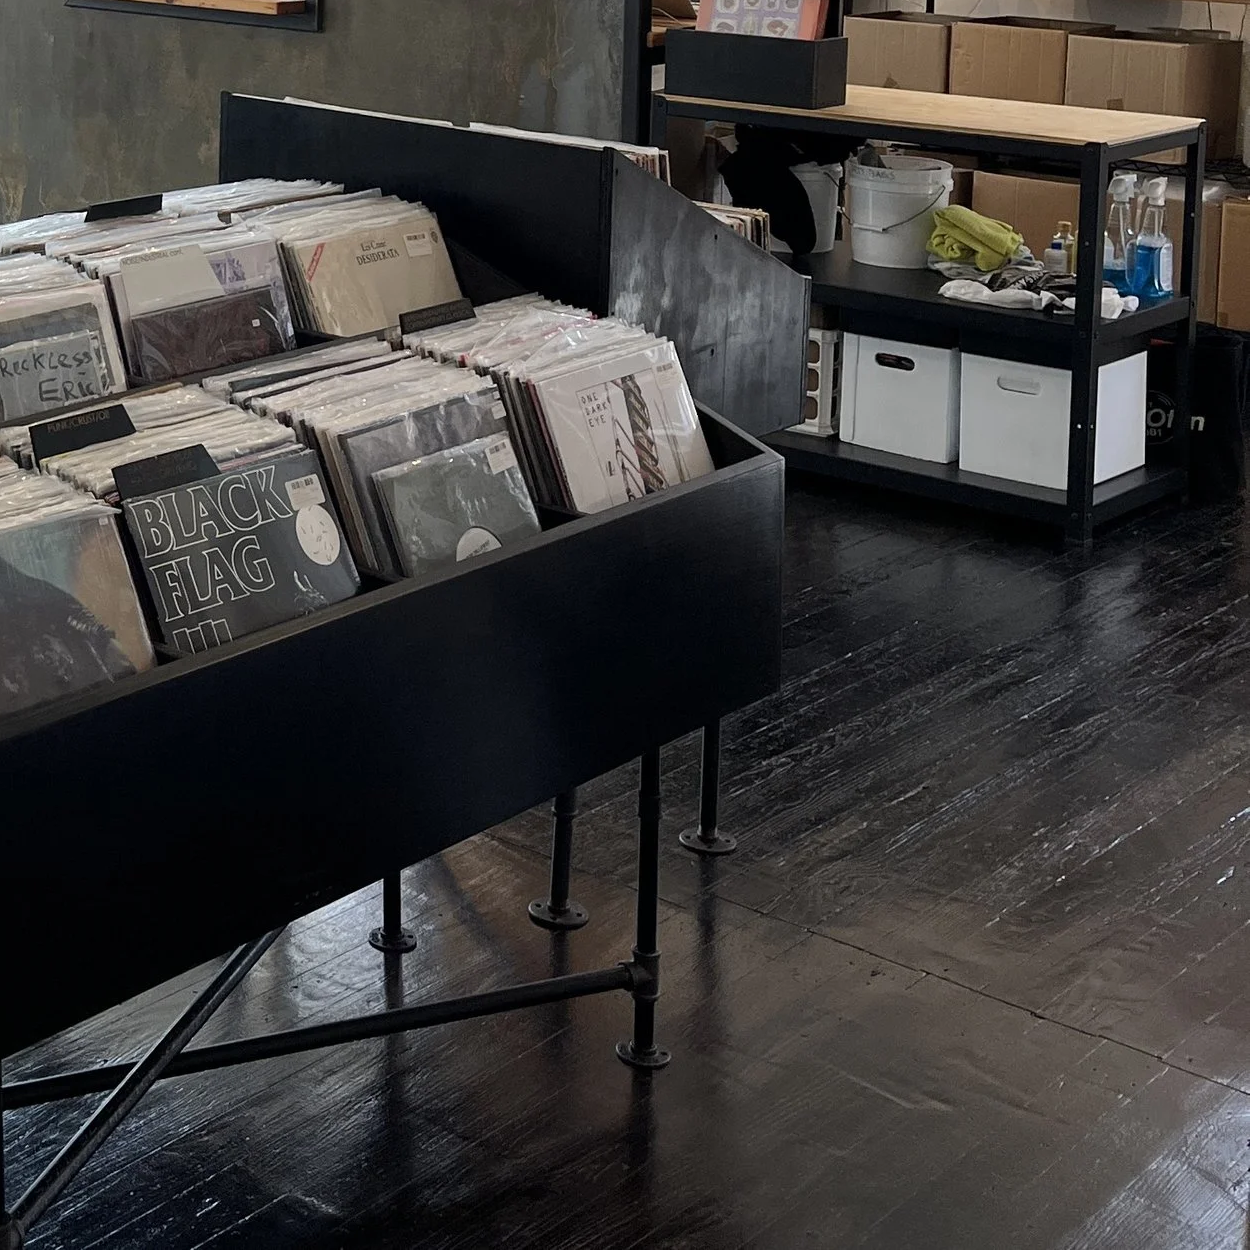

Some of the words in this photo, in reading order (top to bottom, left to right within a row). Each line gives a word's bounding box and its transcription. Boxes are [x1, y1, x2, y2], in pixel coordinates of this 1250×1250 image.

[356, 248, 400, 266] DESIDERATA
[581, 392, 599, 404] ONE
[585, 402, 607, 416] DARK
[588, 414, 607, 428] EYE
[129, 465, 293, 558] BLACK
[149, 535, 276, 623] FLAG
